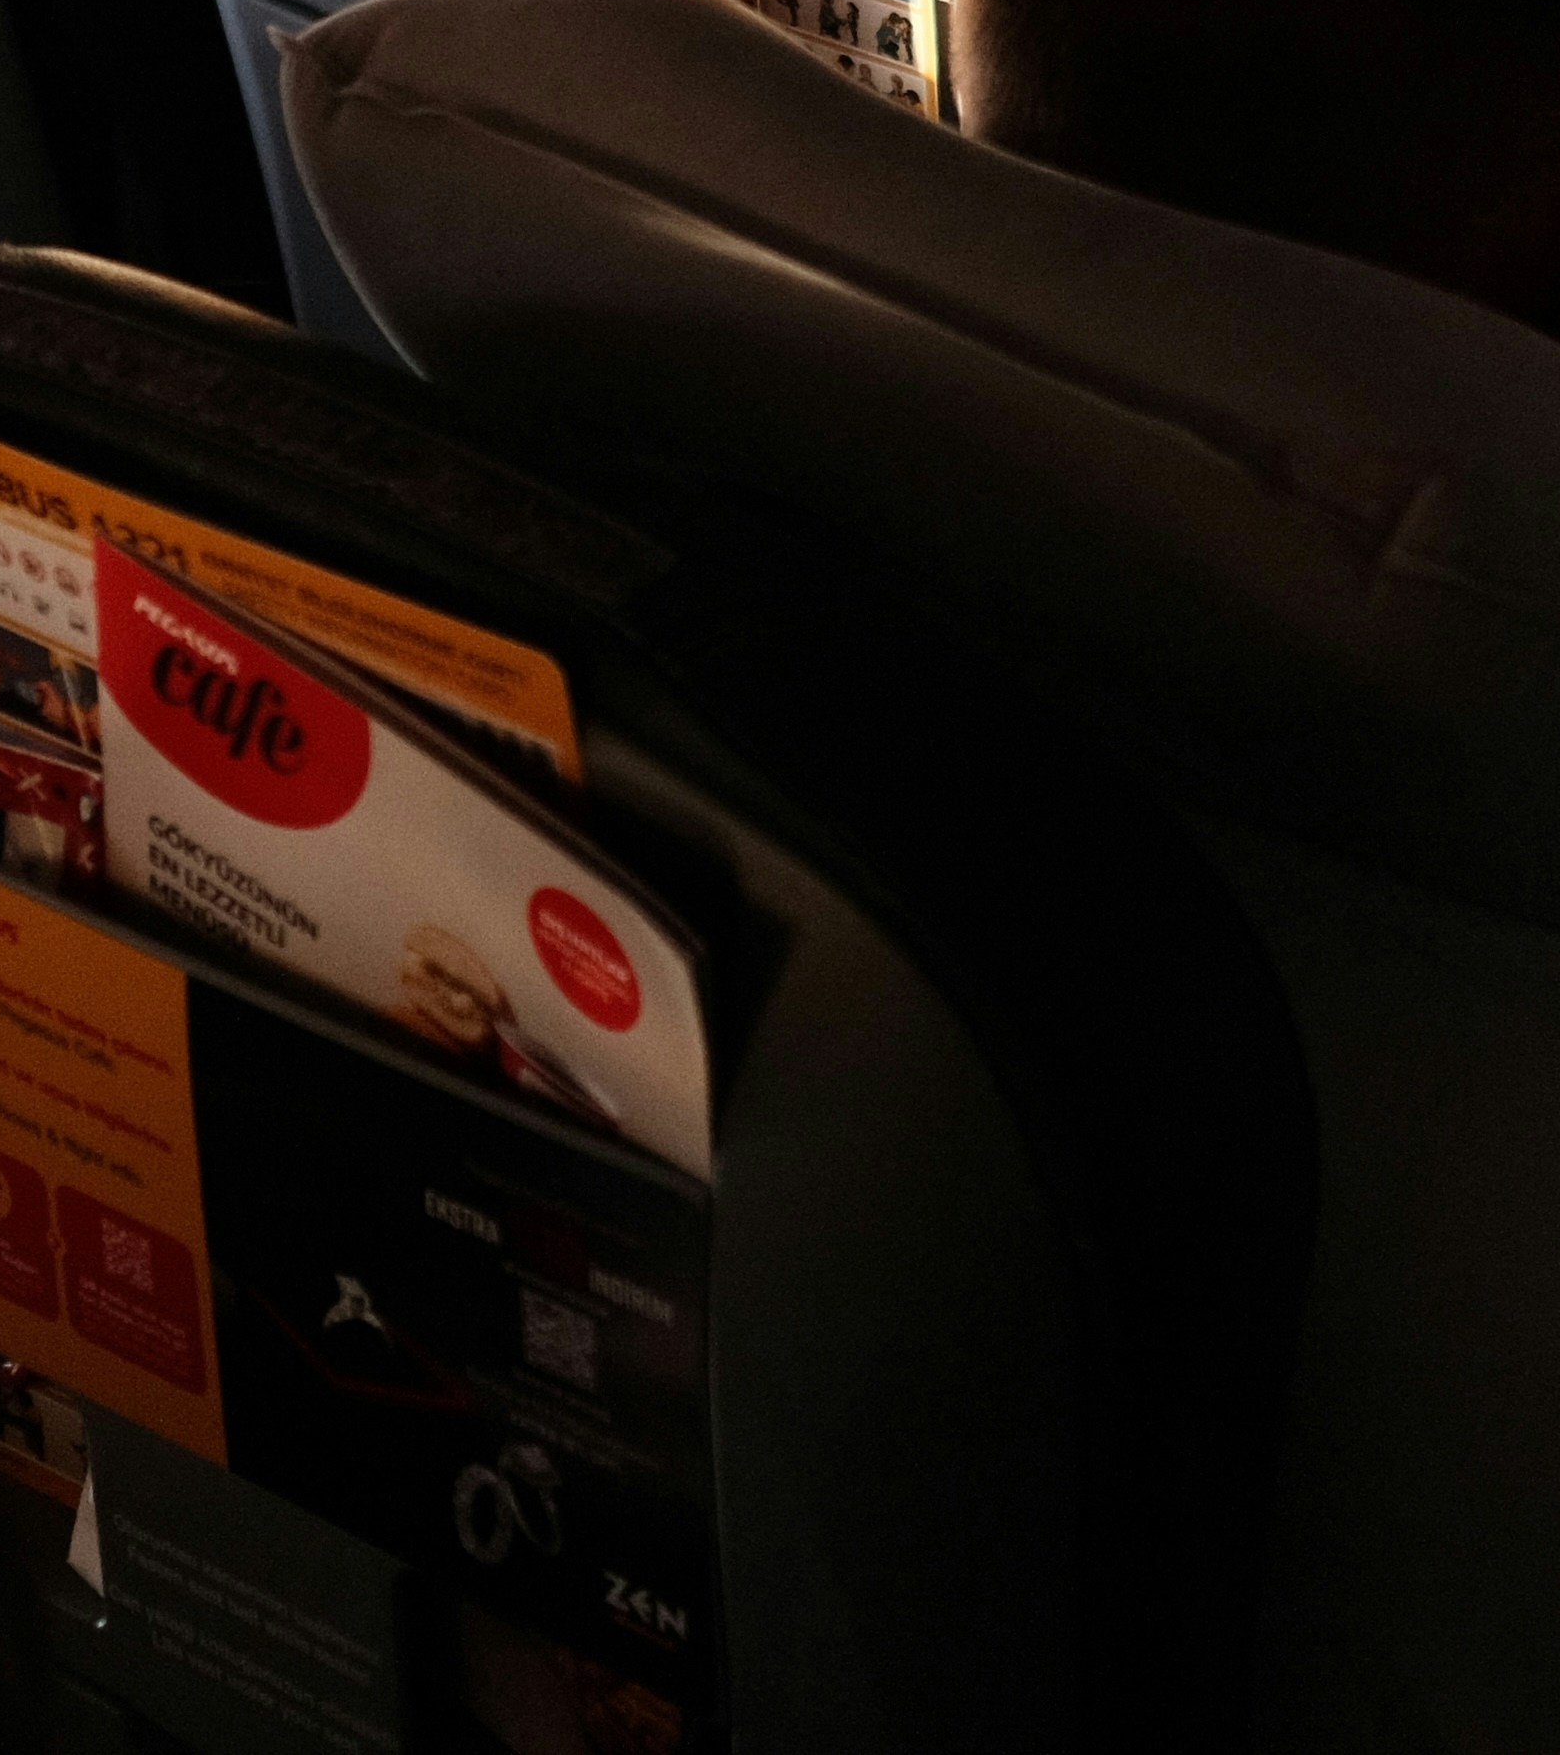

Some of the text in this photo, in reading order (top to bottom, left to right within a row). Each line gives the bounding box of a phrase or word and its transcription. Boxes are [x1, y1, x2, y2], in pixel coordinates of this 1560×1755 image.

[133, 592, 241, 678] PEGASUS
[151, 639, 307, 776] cafe
[146, 813, 321, 944] GÖKYÜZÜNÜN
[148, 841, 179, 879] EN
[604, 1570, 689, 1640] ZEN
